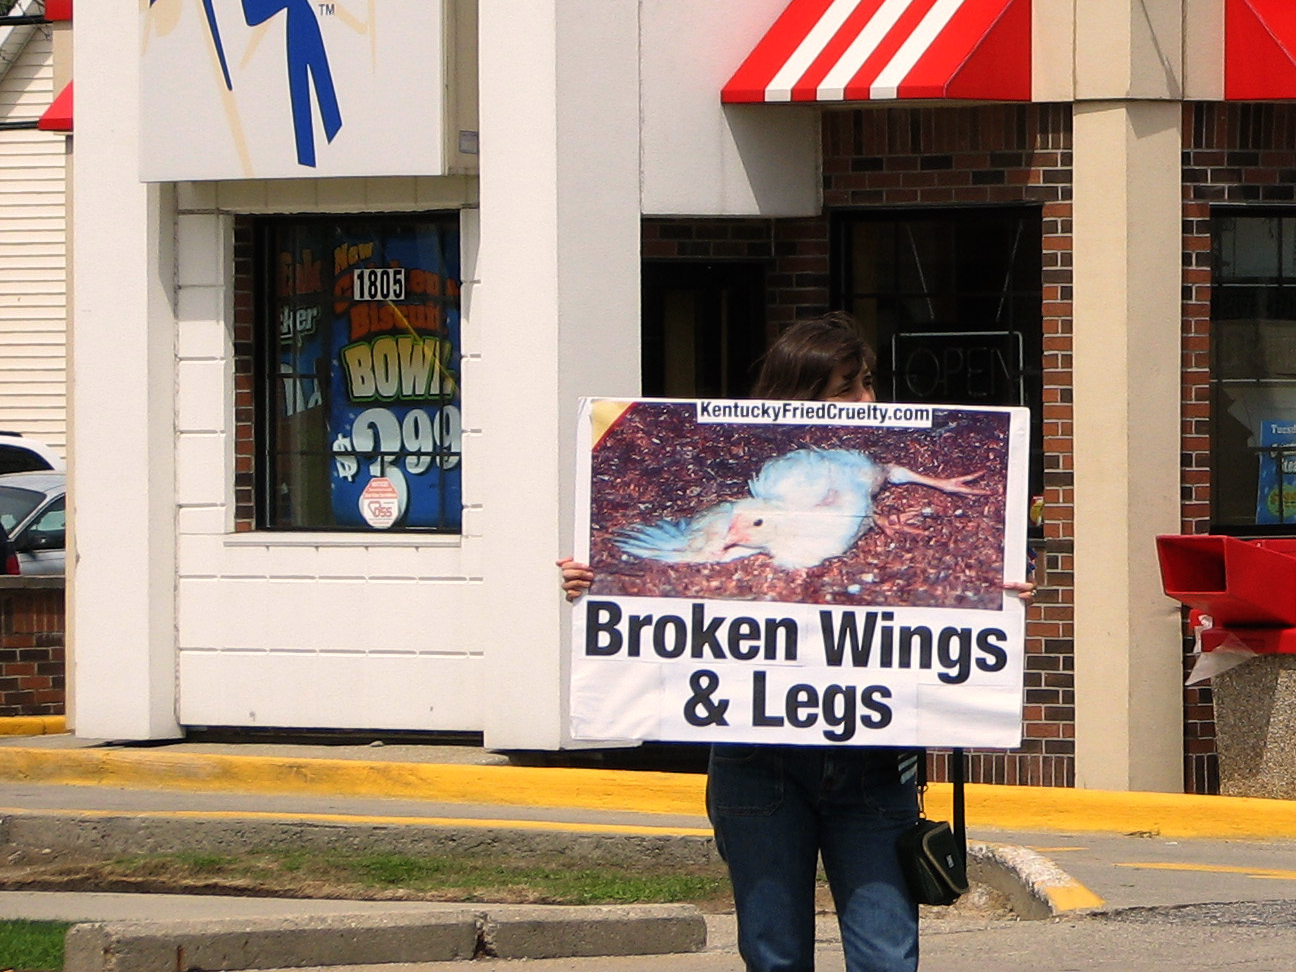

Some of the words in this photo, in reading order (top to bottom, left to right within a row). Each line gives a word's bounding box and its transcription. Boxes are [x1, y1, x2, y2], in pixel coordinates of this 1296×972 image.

[318, 3, 335, 16] TM
[335, 242, 373, 275] New
[356, 269, 403, 300] 1805
[905, 346, 1012, 398] OPEN
[700, 400, 931, 424] KentuckyFriedCruelty.com
[585, 600, 799, 661] Broken
[818, 610, 1009, 685] Wings
[683, 668, 731, 728] &
[752, 670, 893, 742] Legs
